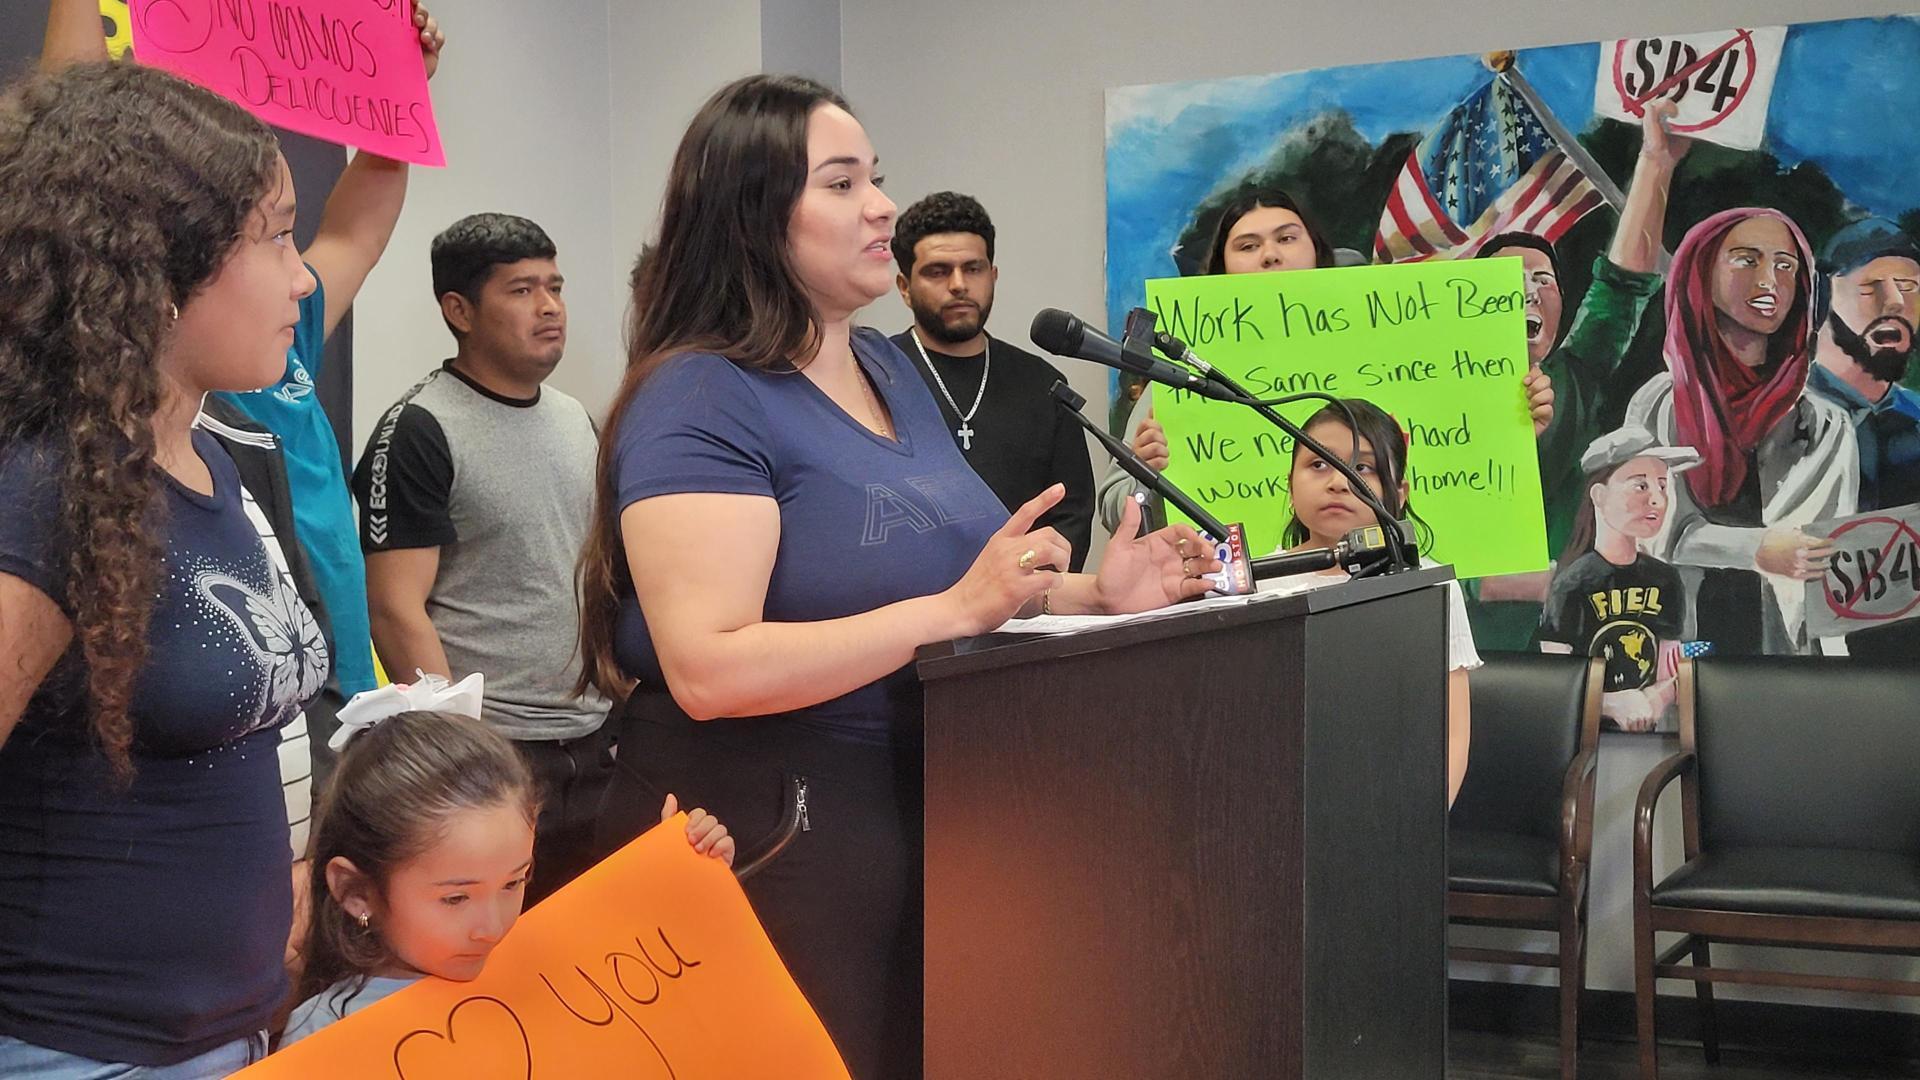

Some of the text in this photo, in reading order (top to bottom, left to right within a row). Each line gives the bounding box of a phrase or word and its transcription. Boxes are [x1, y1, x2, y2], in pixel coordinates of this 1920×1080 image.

[1625, 38, 1740, 113] SB4
[1155, 279, 1525, 347] Work has Not Been
[1452, 350, 1514, 379] then
[1187, 431, 1243, 463] We
[1408, 413, 1471, 446] hard
[1229, 526, 1246, 588] HOUSTON
[1830, 541, 1920, 604] SB4
[1588, 587, 1662, 620] FIEL
